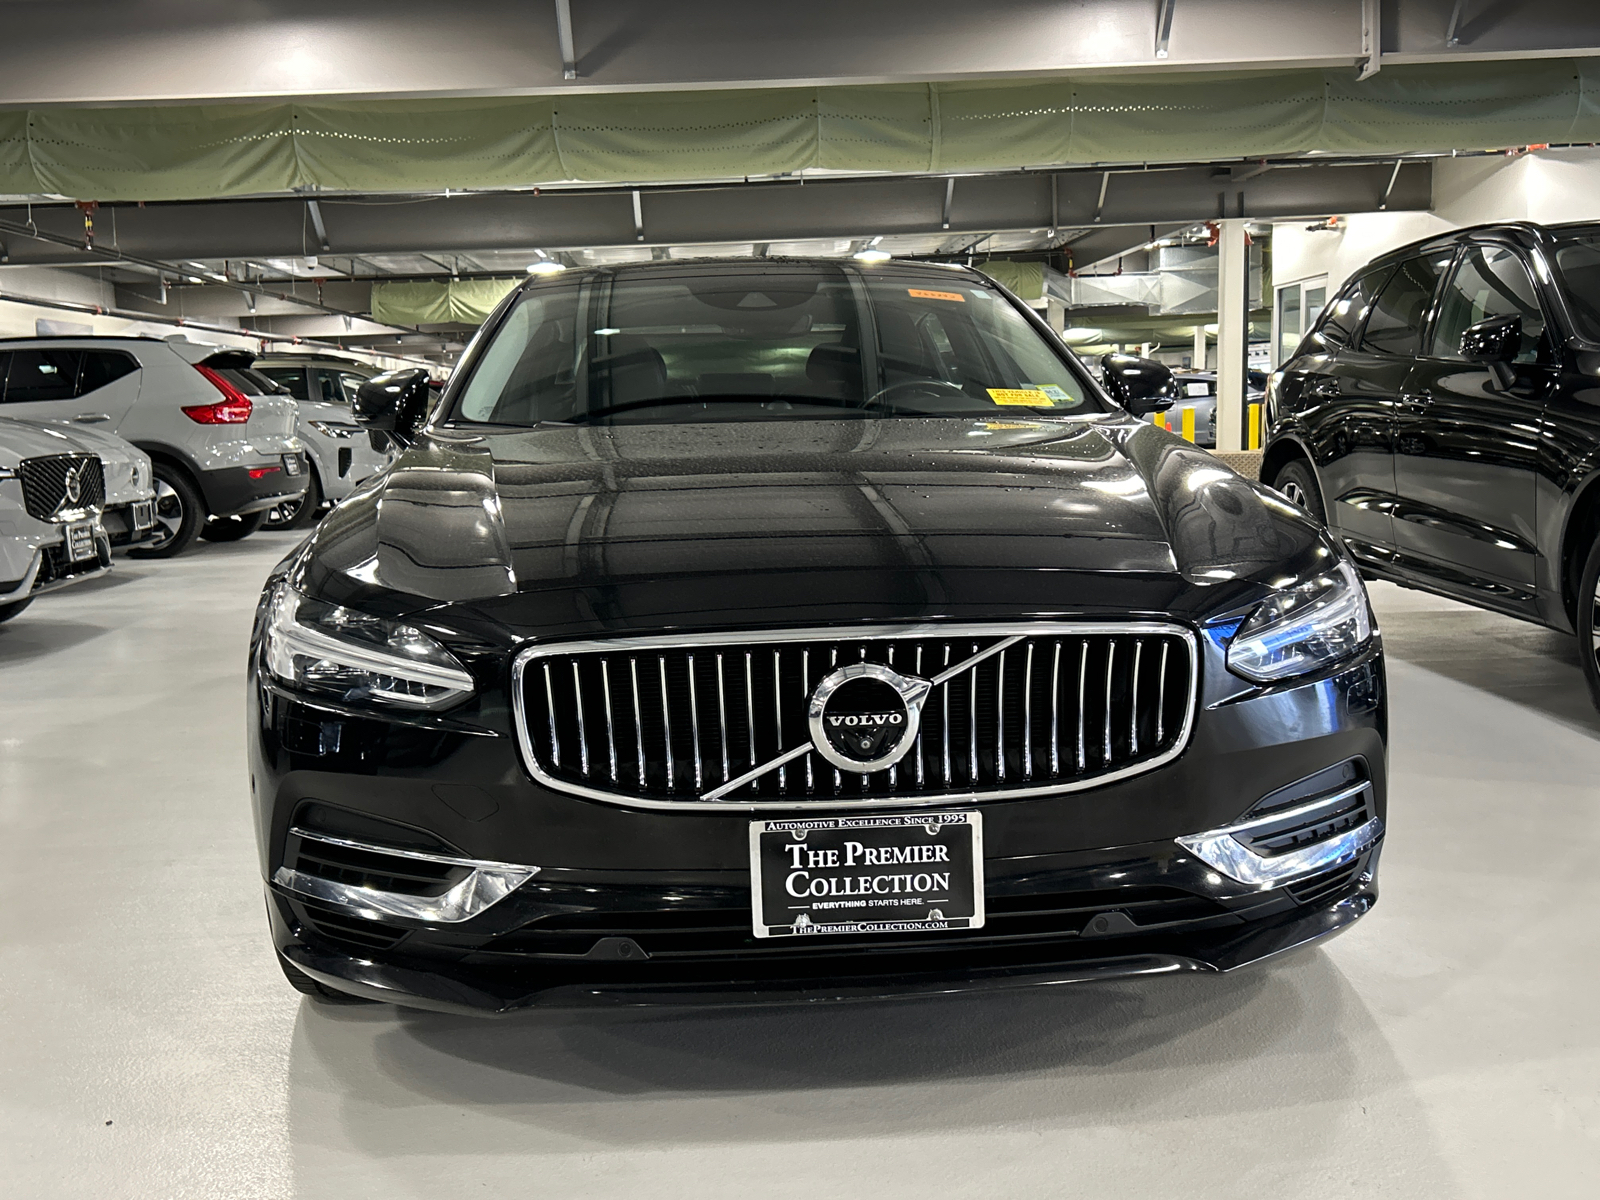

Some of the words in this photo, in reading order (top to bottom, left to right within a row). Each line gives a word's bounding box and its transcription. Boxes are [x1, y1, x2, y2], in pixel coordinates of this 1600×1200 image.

[826, 713, 903, 727] VOLVO
[766, 820, 836, 831] AUTOMOTIVE
[838, 817, 902, 828] EXCELLENCE
[904, 815, 935, 825] SINCE
[937, 814, 966, 824] 1995
[785, 843, 840, 869] THE
[844, 841, 950, 867] PREMIER
[785, 870, 951, 898] COLLECTION
[812, 900, 867, 910] EVERYTHING
[868, 899, 899, 908] STARTS
[900, 898, 925, 906] HERE.
